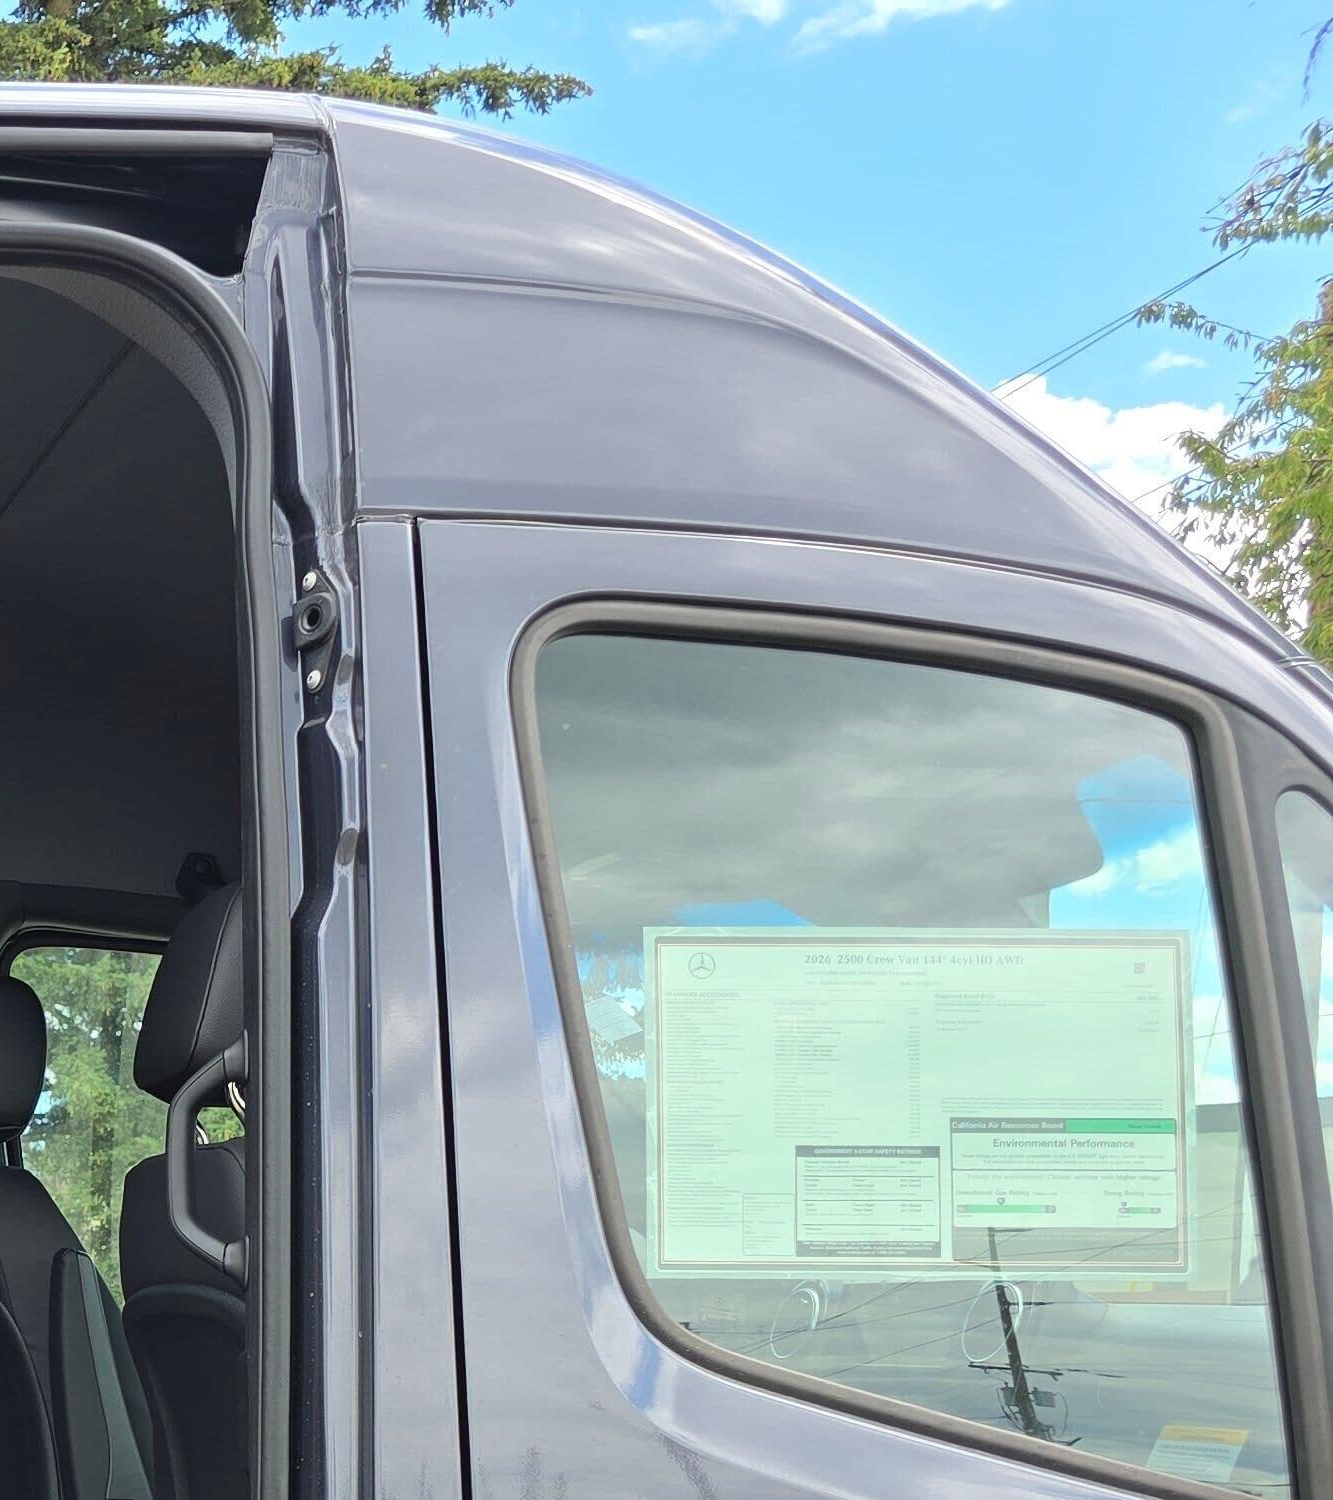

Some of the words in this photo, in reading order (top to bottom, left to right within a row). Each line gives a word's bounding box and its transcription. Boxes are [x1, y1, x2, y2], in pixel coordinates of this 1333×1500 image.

[804, 954, 831, 965] 2026
[837, 954, 864, 965] 2500
[866, 955, 895, 965] Crew
[897, 955, 920, 965] Van
[995, 955, 1024, 966] AWD
[952, 1121, 987, 1129] California
[992, 1138, 1067, 1148] Environmental
[1070, 1139, 1135, 1149] Performance
